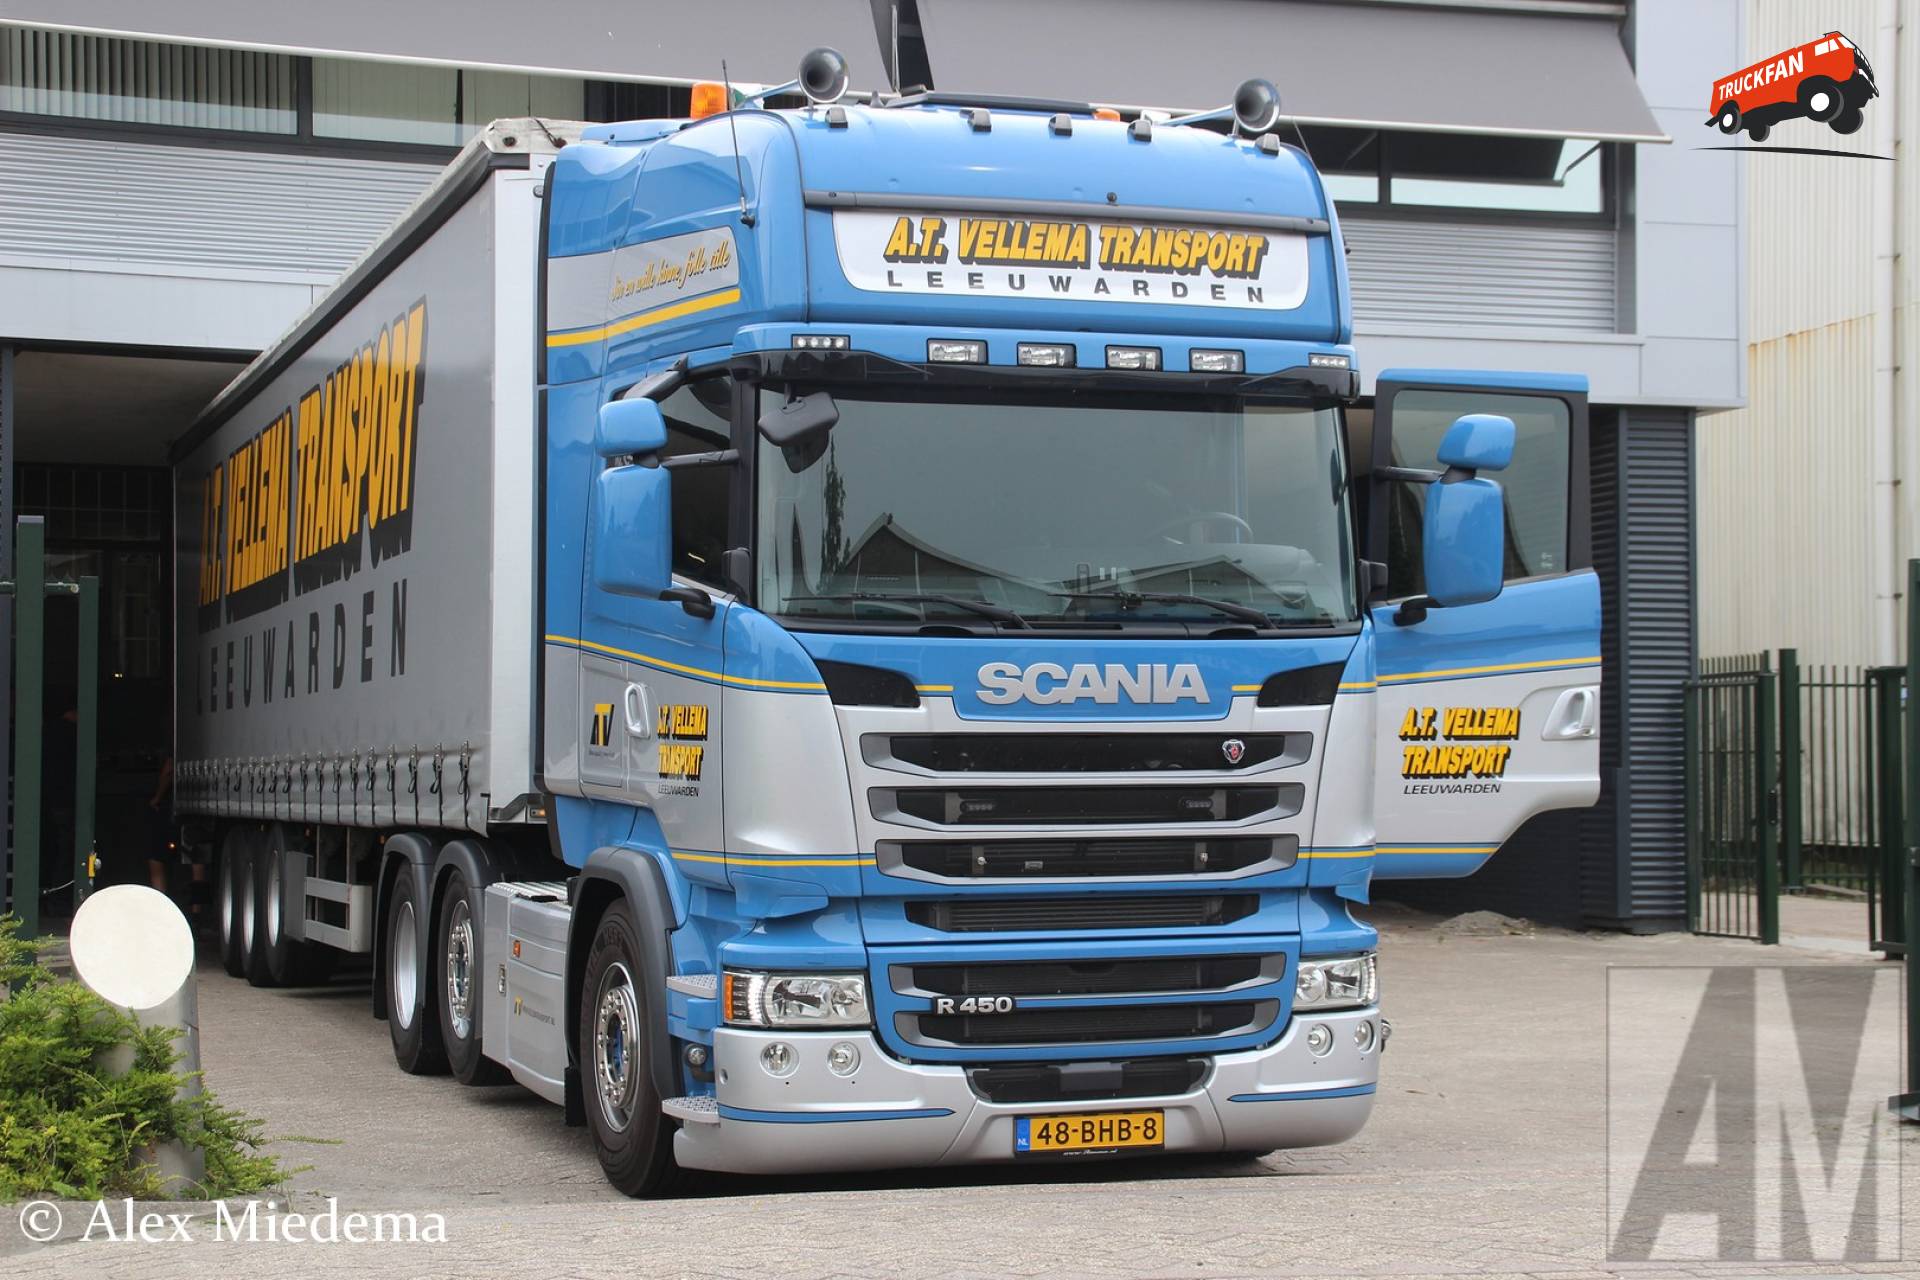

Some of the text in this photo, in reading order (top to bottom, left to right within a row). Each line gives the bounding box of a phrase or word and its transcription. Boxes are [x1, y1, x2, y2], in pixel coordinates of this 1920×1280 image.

[883, 216, 1269, 280] A.T. VELLEMA TRANSPORT
[887, 269, 1265, 304] LEEUWARDEN
[225, 405, 293, 616] VELLEMA
[293, 295, 428, 597] TRANSPORT
[197, 578, 408, 716] LEEUWARDEN
[976, 662, 1211, 705] SCANIA
[671, 704, 709, 741] VELLEMA
[1398, 706, 1521, 741] A.T. VELLEMA
[658, 744, 704, 781] TRANSPORT
[1402, 745, 1512, 779] TRANSPORT
[658, 784, 700, 798] LEEUWARDEN
[1403, 783, 1502, 796] LEEUWARDEN
[936, 996, 1013, 1015] R 450
[1017, 1138, 1029, 1146] NL
[1036, 1117, 1157, 1146] 48-BHB-8
